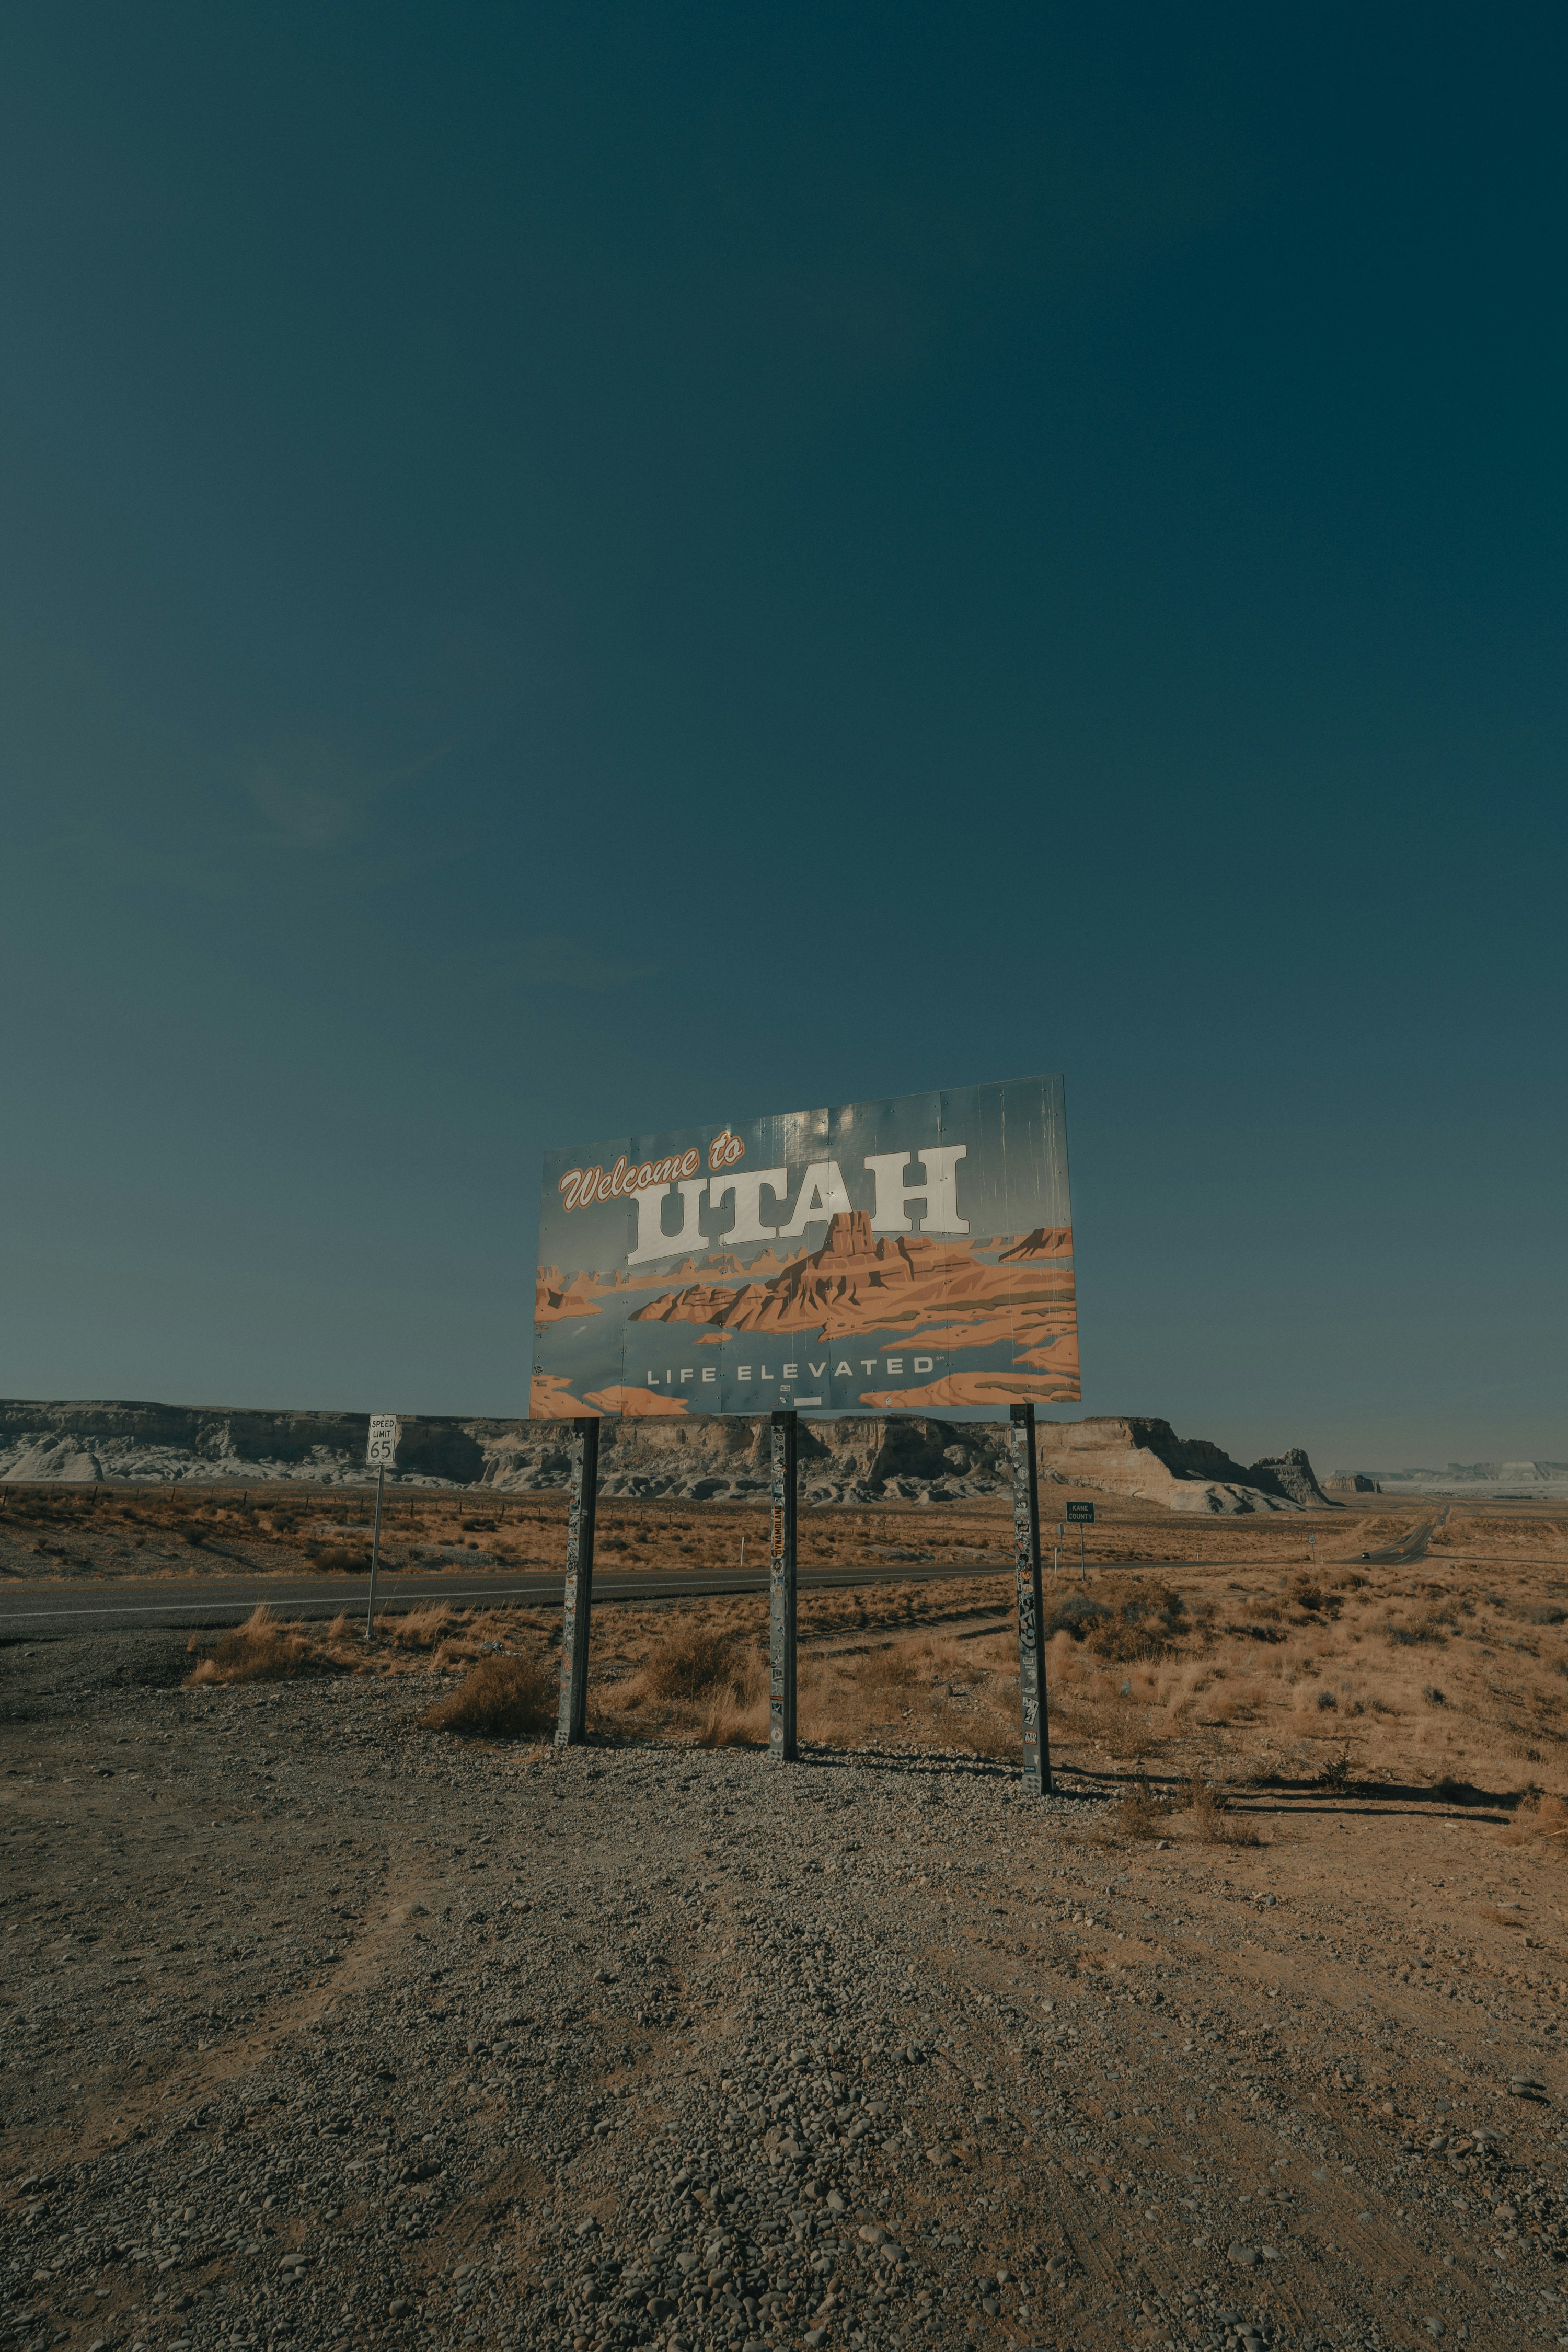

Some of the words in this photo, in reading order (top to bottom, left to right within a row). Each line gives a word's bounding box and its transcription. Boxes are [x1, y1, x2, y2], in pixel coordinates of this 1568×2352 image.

[560, 1148, 699, 1211] Welcome
[709, 1132, 743, 1170] to
[627, 1144, 970, 1266] UTAH
[648, 1367, 716, 1385] LIFE
[737, 1357, 933, 1380] ELEVATED
[371, 1441, 390, 1458] 65
